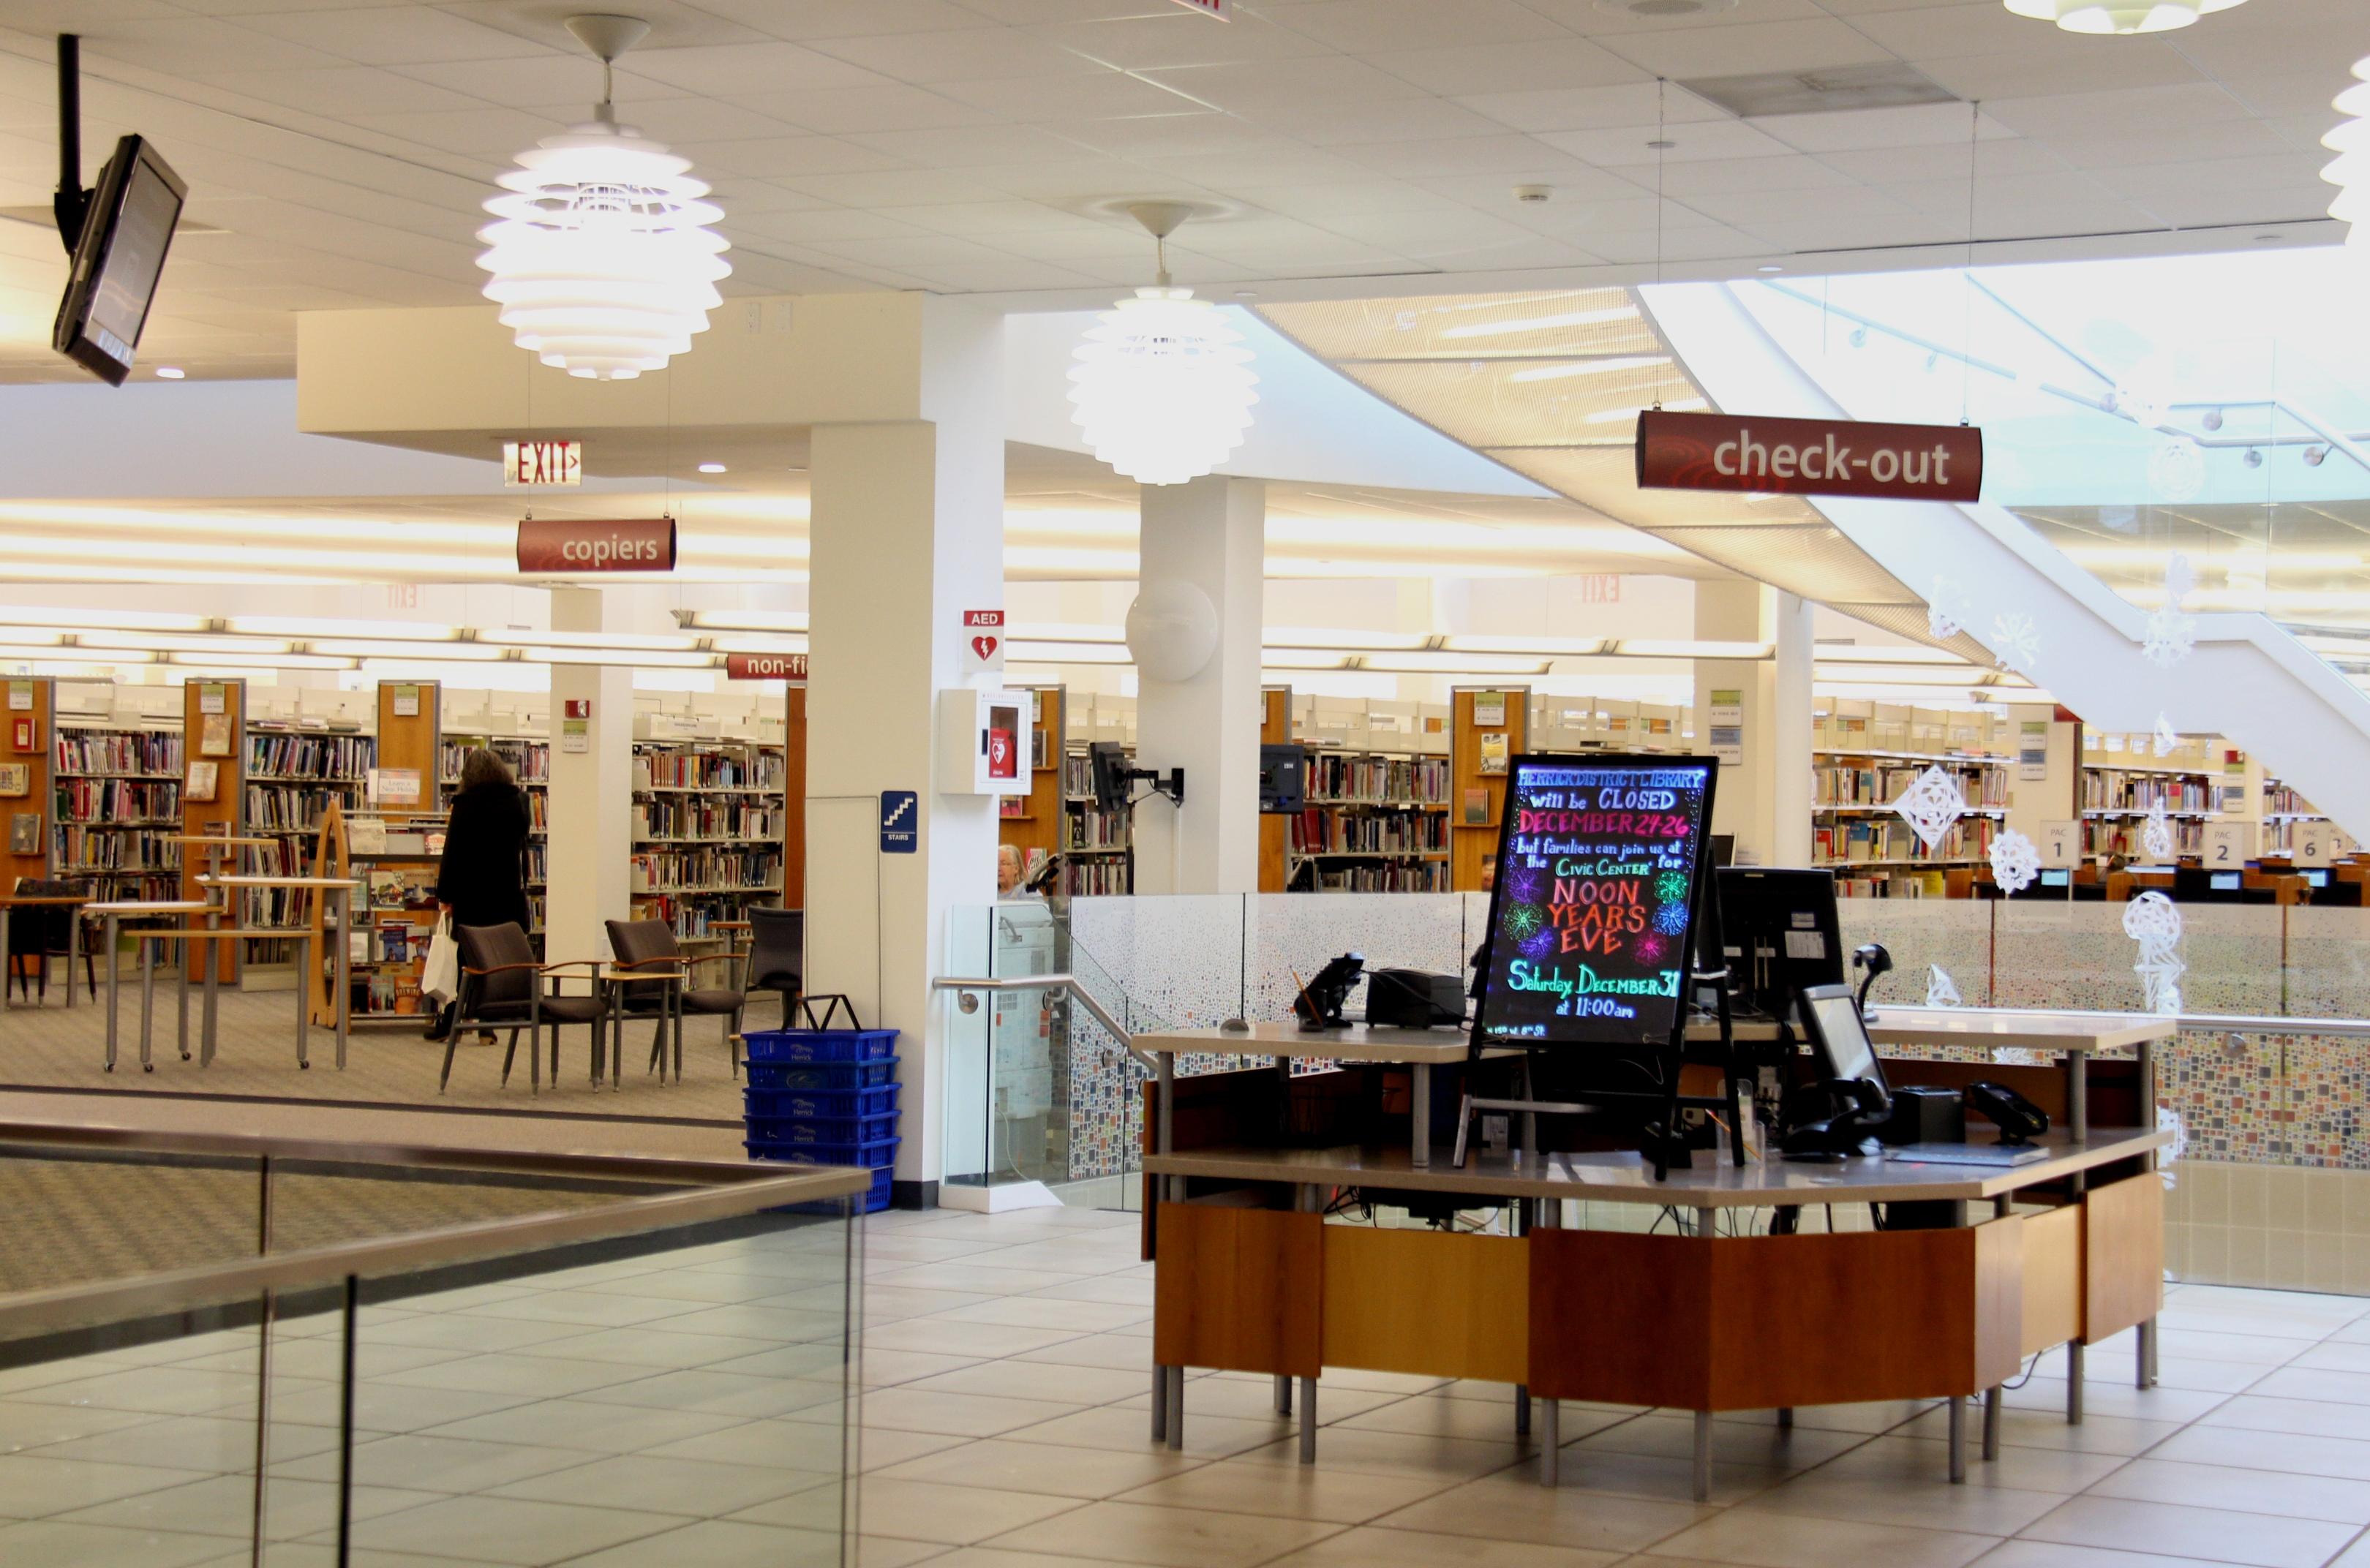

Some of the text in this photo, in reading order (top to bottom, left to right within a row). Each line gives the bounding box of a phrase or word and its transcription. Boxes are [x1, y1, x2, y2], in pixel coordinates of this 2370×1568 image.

[518, 442, 570, 483] EXIT
[1713, 429, 1949, 485] check-out
[563, 534, 658, 567] copiers
[971, 614, 998, 625] AED
[748, 656, 808, 674] non-fi
[1518, 771, 1703, 788] HERRICK DISTRICT LIBRARY
[1530, 788, 1675, 810] will be CLOSED
[1519, 810, 1689, 836] DECEMBER 24-26
[2050, 829, 2066, 837] PAC
[2214, 831, 2231, 839] PAC
[1516, 836, 1682, 862] but families can join us at
[2054, 843, 2061, 857] 1
[2216, 845, 2228, 860] 2
[2305, 842, 2316, 856] 6
[1527, 854, 1546, 868] the
[1658, 855, 1682, 869] for
[1553, 879, 1639, 905] NOON
[1547, 903, 1647, 933] YEARS
[1560, 927, 1622, 955] EVE
[1576, 963, 1658, 995] DECEMBER
[1658, 971, 1680, 998] 31
[1556, 1000, 1569, 1015] at
